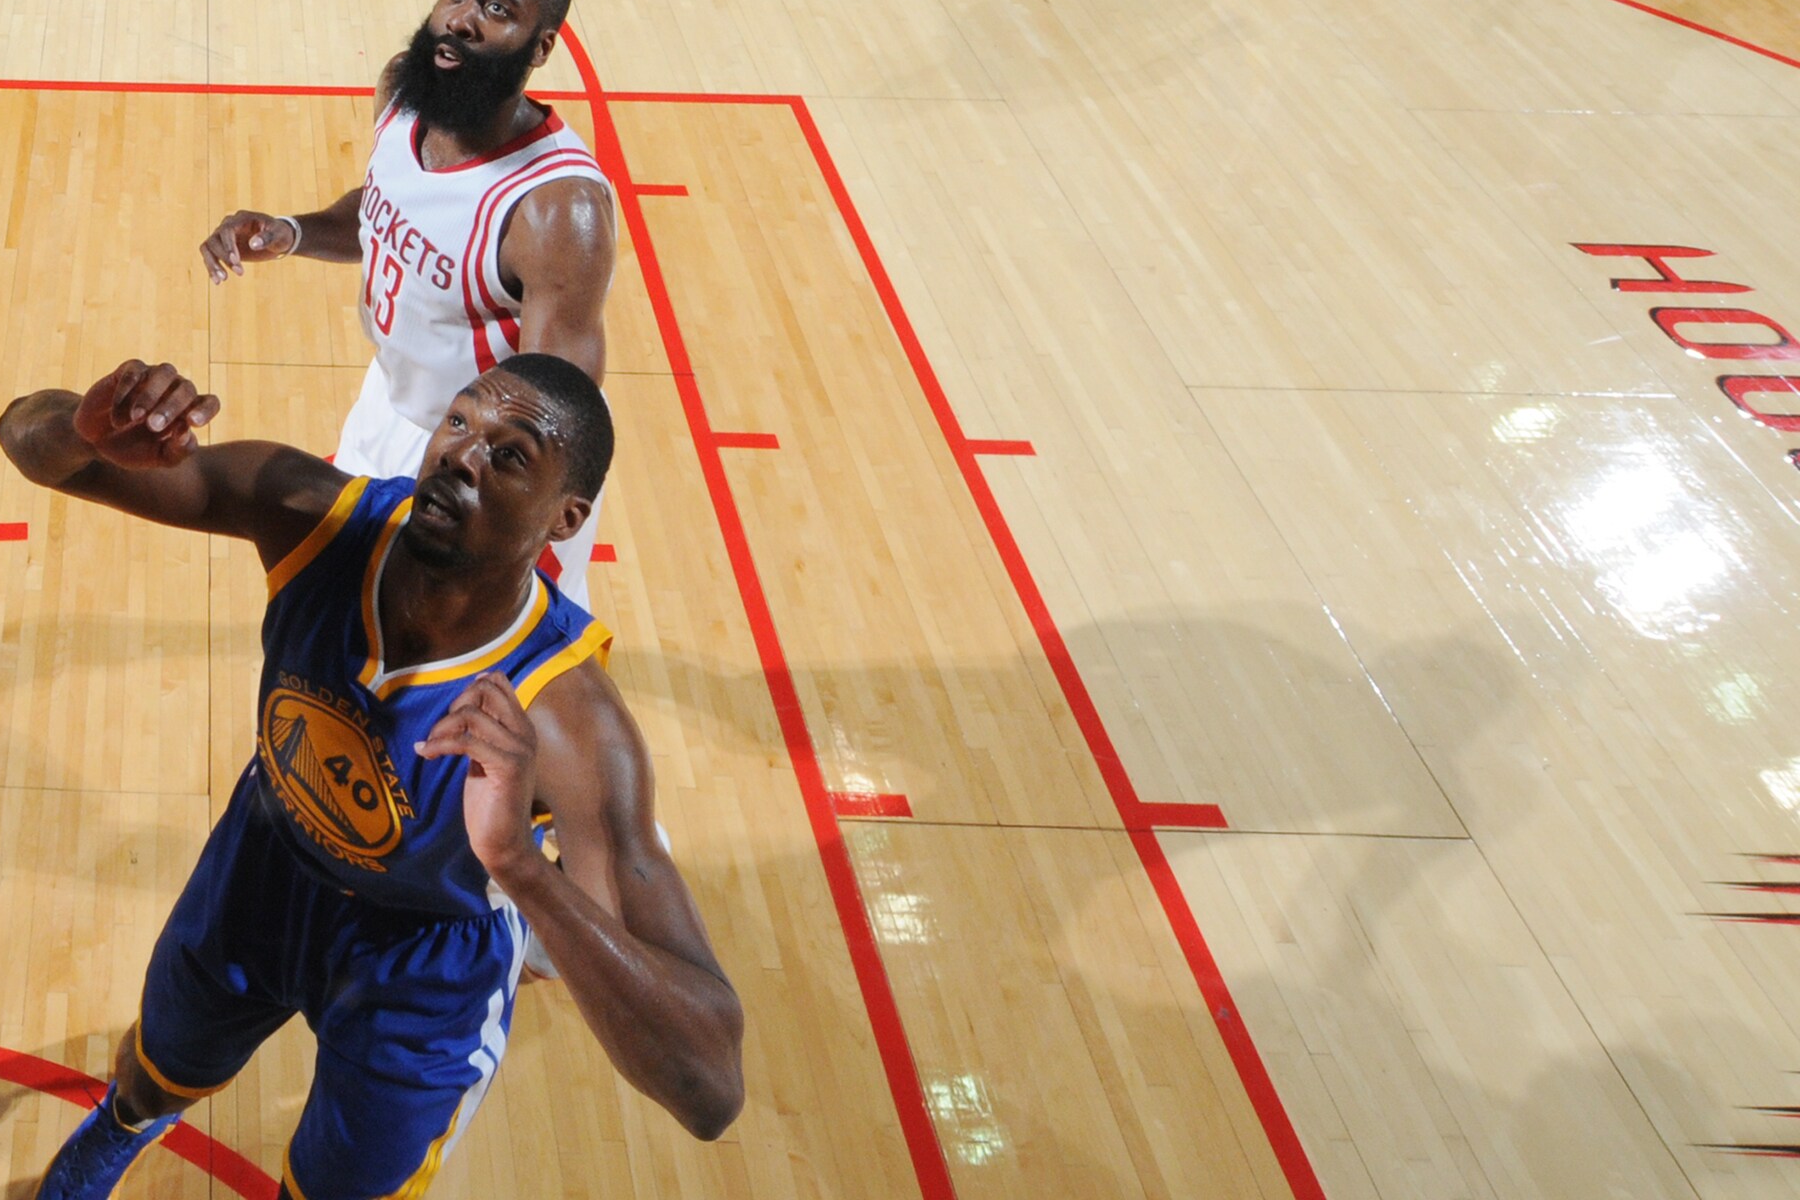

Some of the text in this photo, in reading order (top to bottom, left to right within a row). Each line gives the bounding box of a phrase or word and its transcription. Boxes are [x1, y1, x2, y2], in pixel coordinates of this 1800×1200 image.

[361, 166, 456, 291] ROCKETS
[365, 235, 404, 337] 13
[257, 734, 389, 874] WARRIORS
[278, 670, 418, 820] GOLDEN STATE
[322, 754, 380, 811] 40
